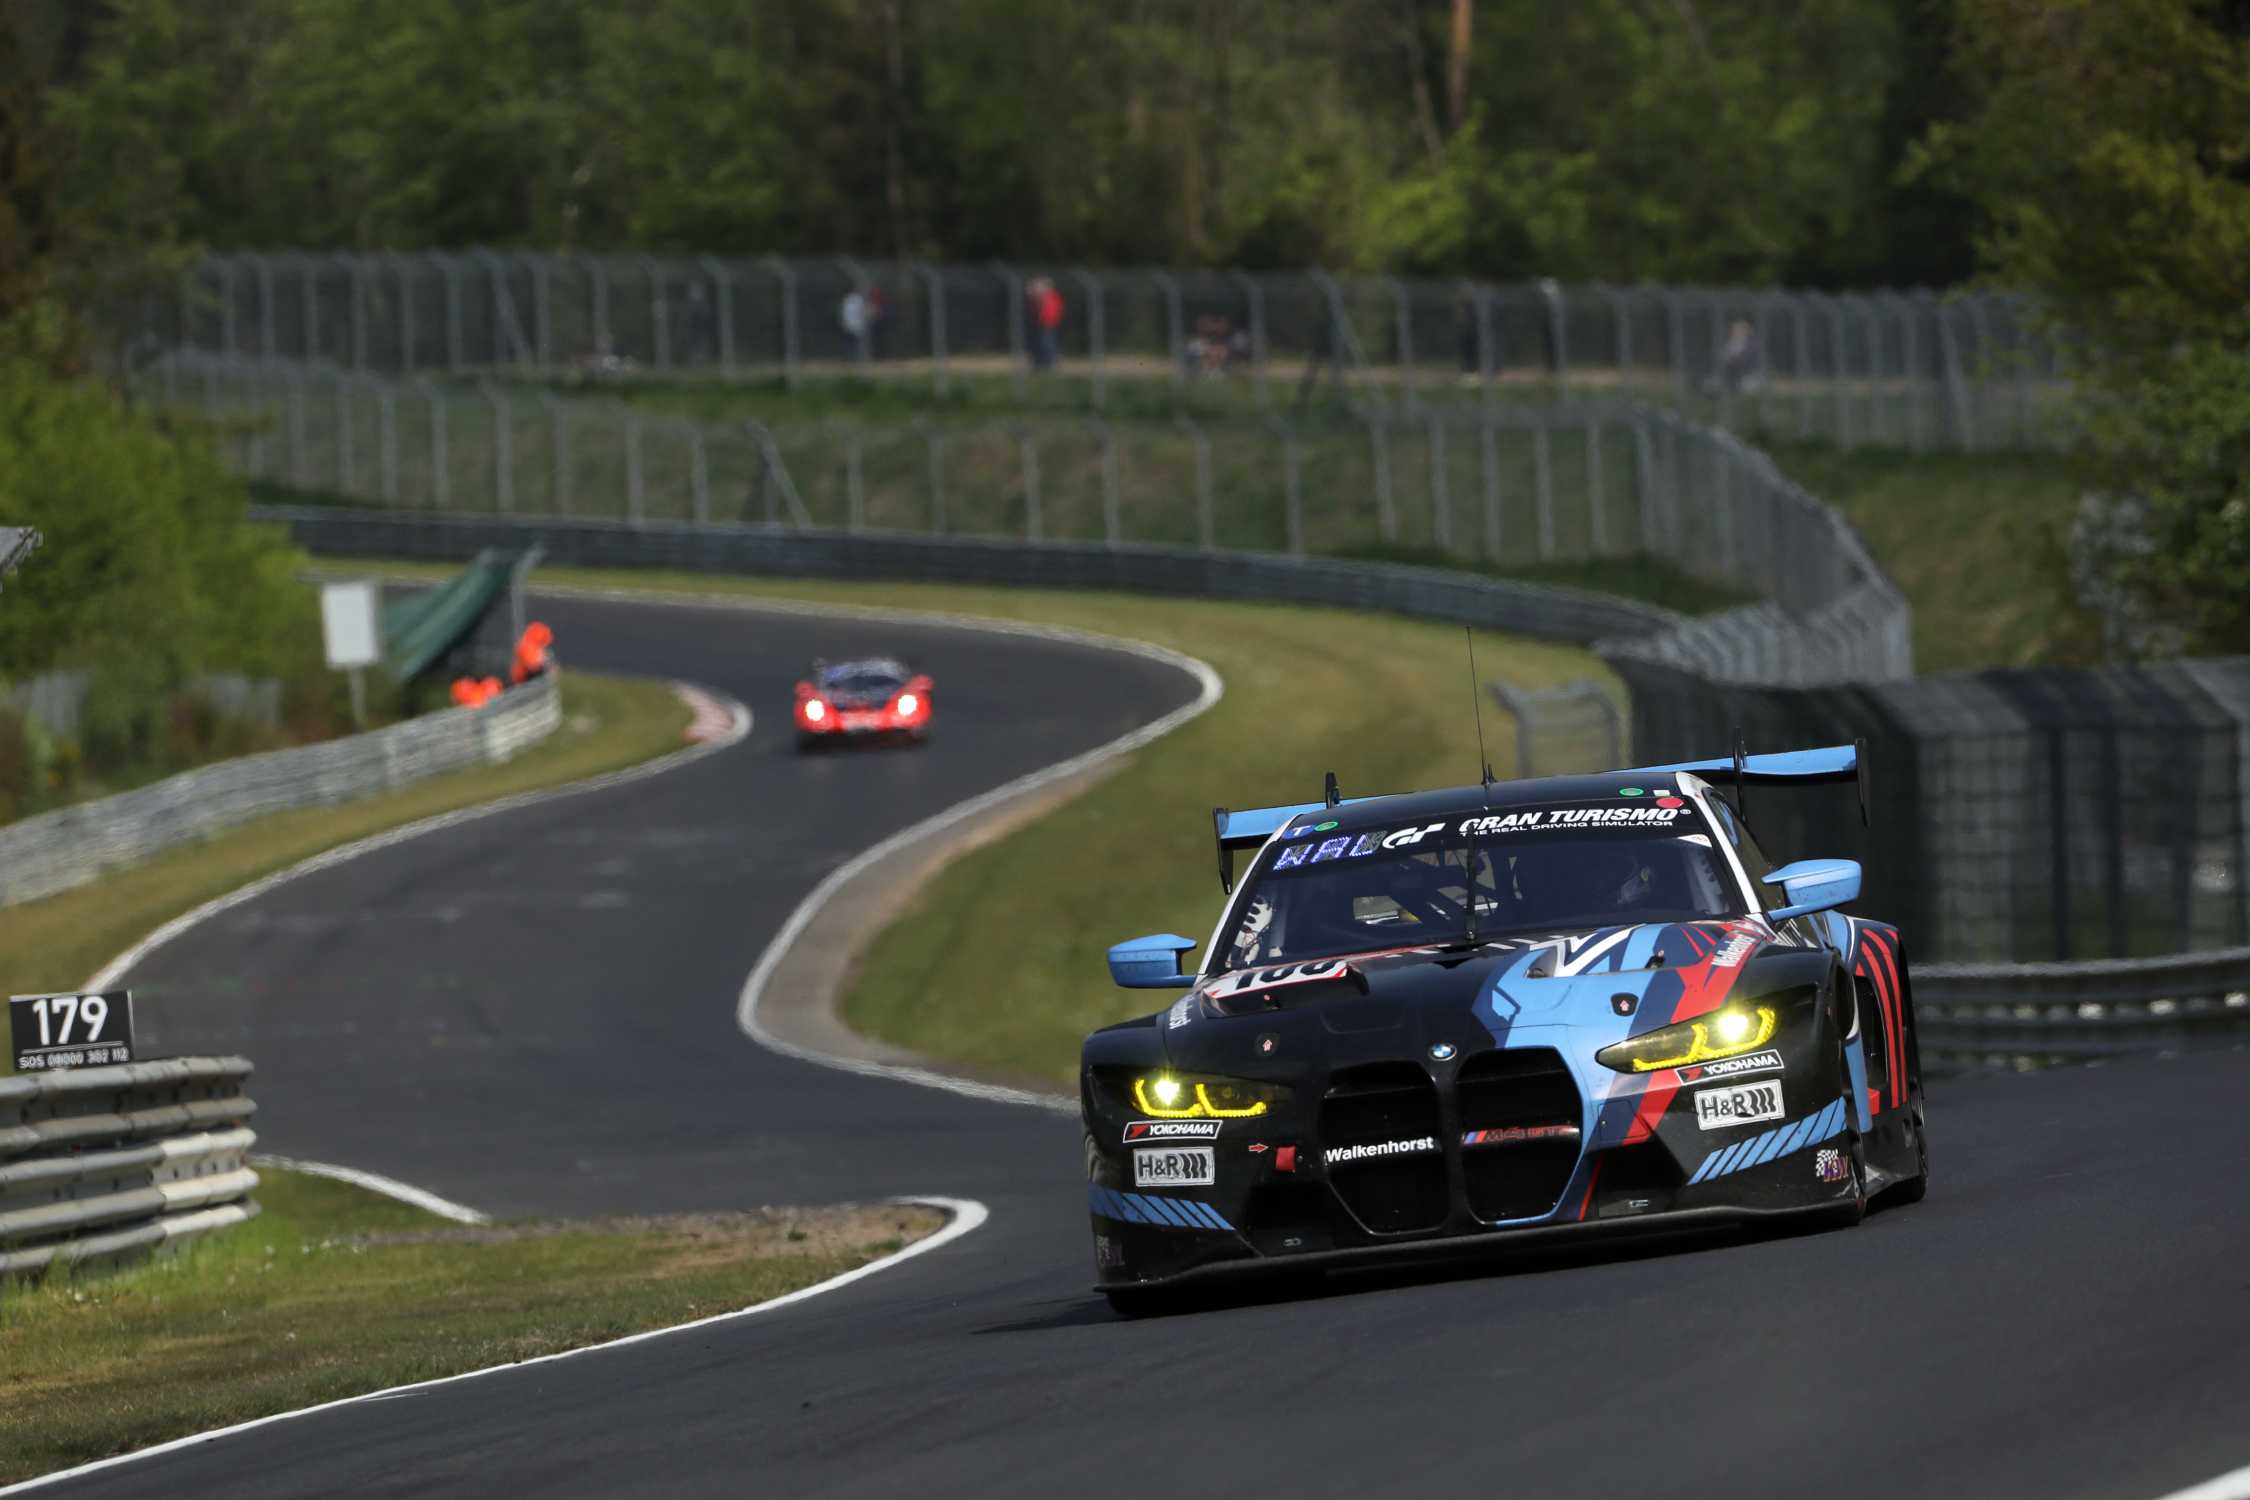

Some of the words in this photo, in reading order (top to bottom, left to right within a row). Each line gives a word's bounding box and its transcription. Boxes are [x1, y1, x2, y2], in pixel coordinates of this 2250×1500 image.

[1459, 811, 1543, 832] GRAN
[1549, 808, 1679, 823] TURISMO
[1531, 821, 1589, 830] DRIVING
[32, 995, 109, 1046] 179
[18, 1054, 46, 1070] SOS
[111, 1046, 129, 1062] 112
[1704, 1054, 1779, 1075] YOKOHAMA
[1700, 1092, 1749, 1120] H&R
[1148, 1123, 1214, 1136] YOKOHAMA
[1326, 1135, 1434, 1164] Walkenhorst
[1137, 1153, 1182, 1178] H&R
